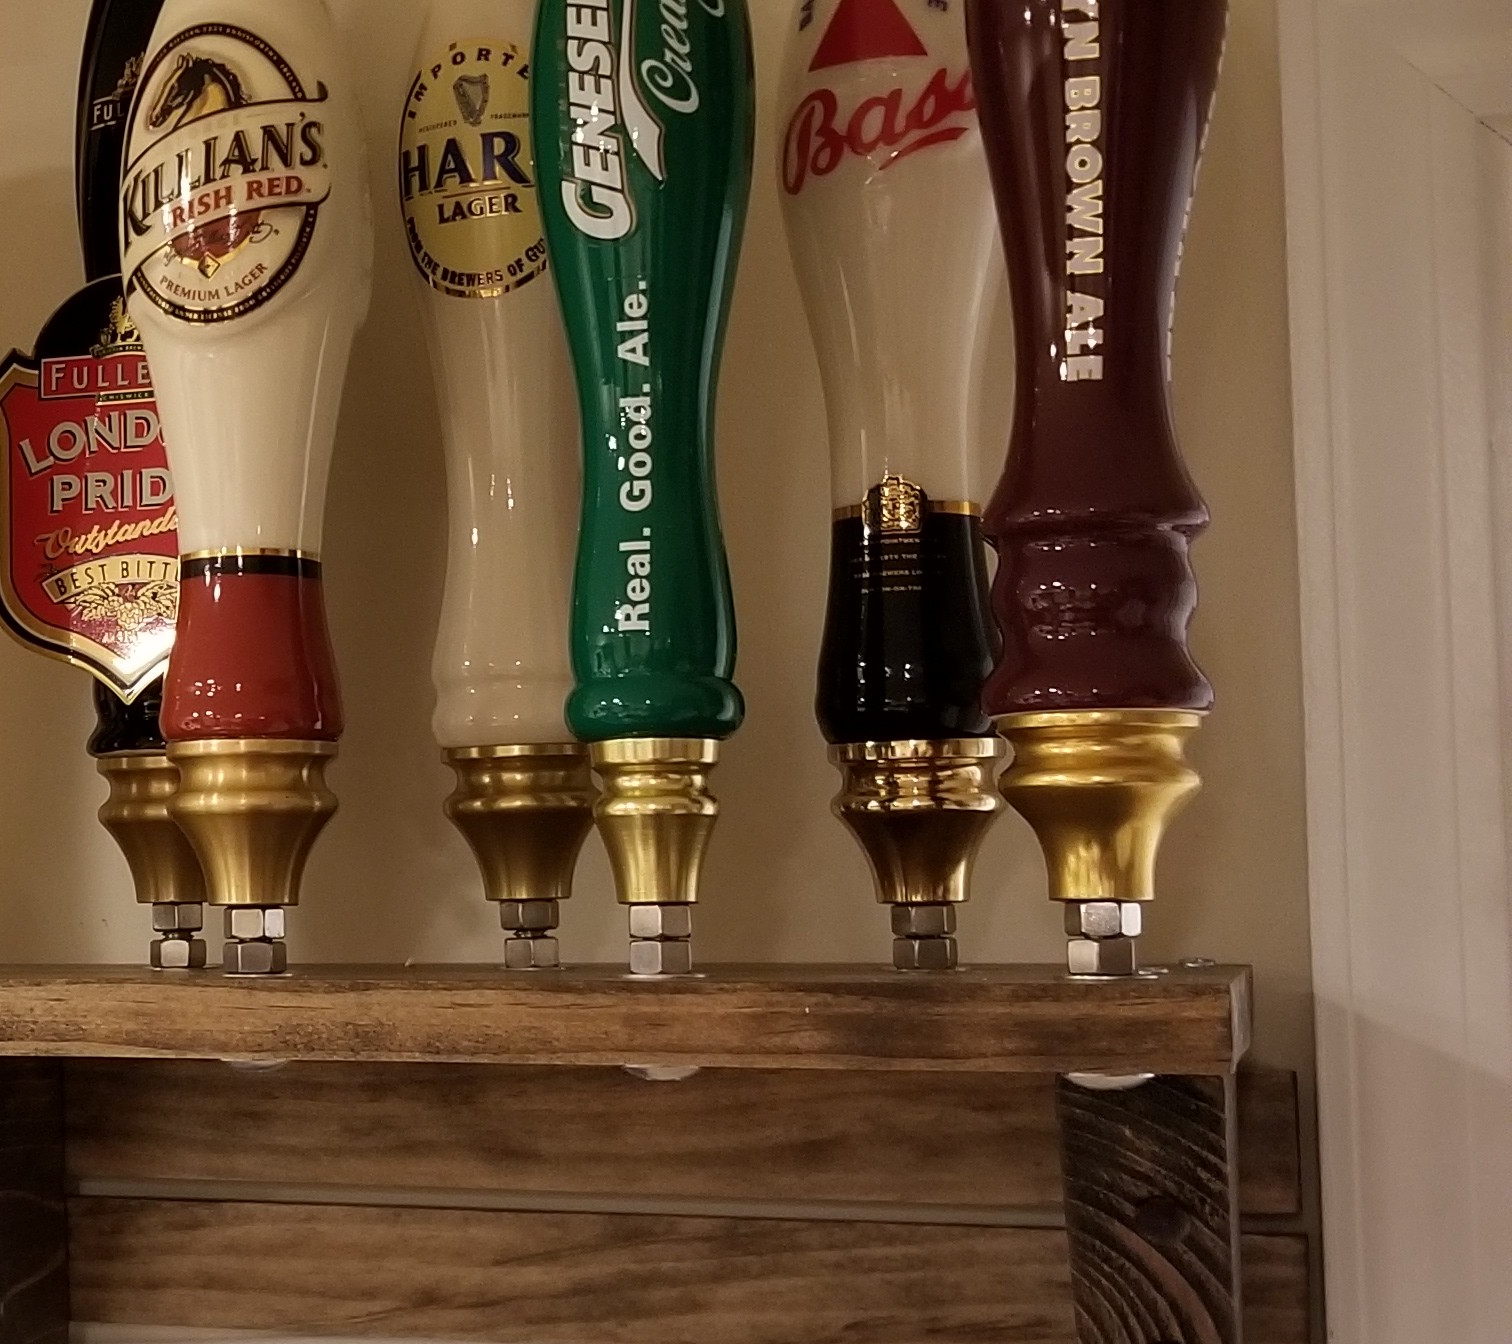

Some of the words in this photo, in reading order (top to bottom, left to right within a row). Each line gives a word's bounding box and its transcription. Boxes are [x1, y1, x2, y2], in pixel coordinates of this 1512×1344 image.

[169, 186, 234, 229] RISH
[245, 175, 304, 202] RED
[438, 193, 523, 225] LAGER
[1064, 74, 1105, 276] BROWN
[159, 274, 221, 302] PREMIUM
[224, 262, 269, 298] LAGER
[421, 251, 441, 276] THE
[441, 267, 504, 287] BREWERS
[507, 258, 526, 277] OF
[615, 279, 651, 367] Ale.
[1064, 290, 1104, 384] ALE
[19, 407, 168, 478] LOND
[618, 382, 653, 513] Good.
[54, 562, 107, 597] BEST
[617, 527, 652, 633] Real.
